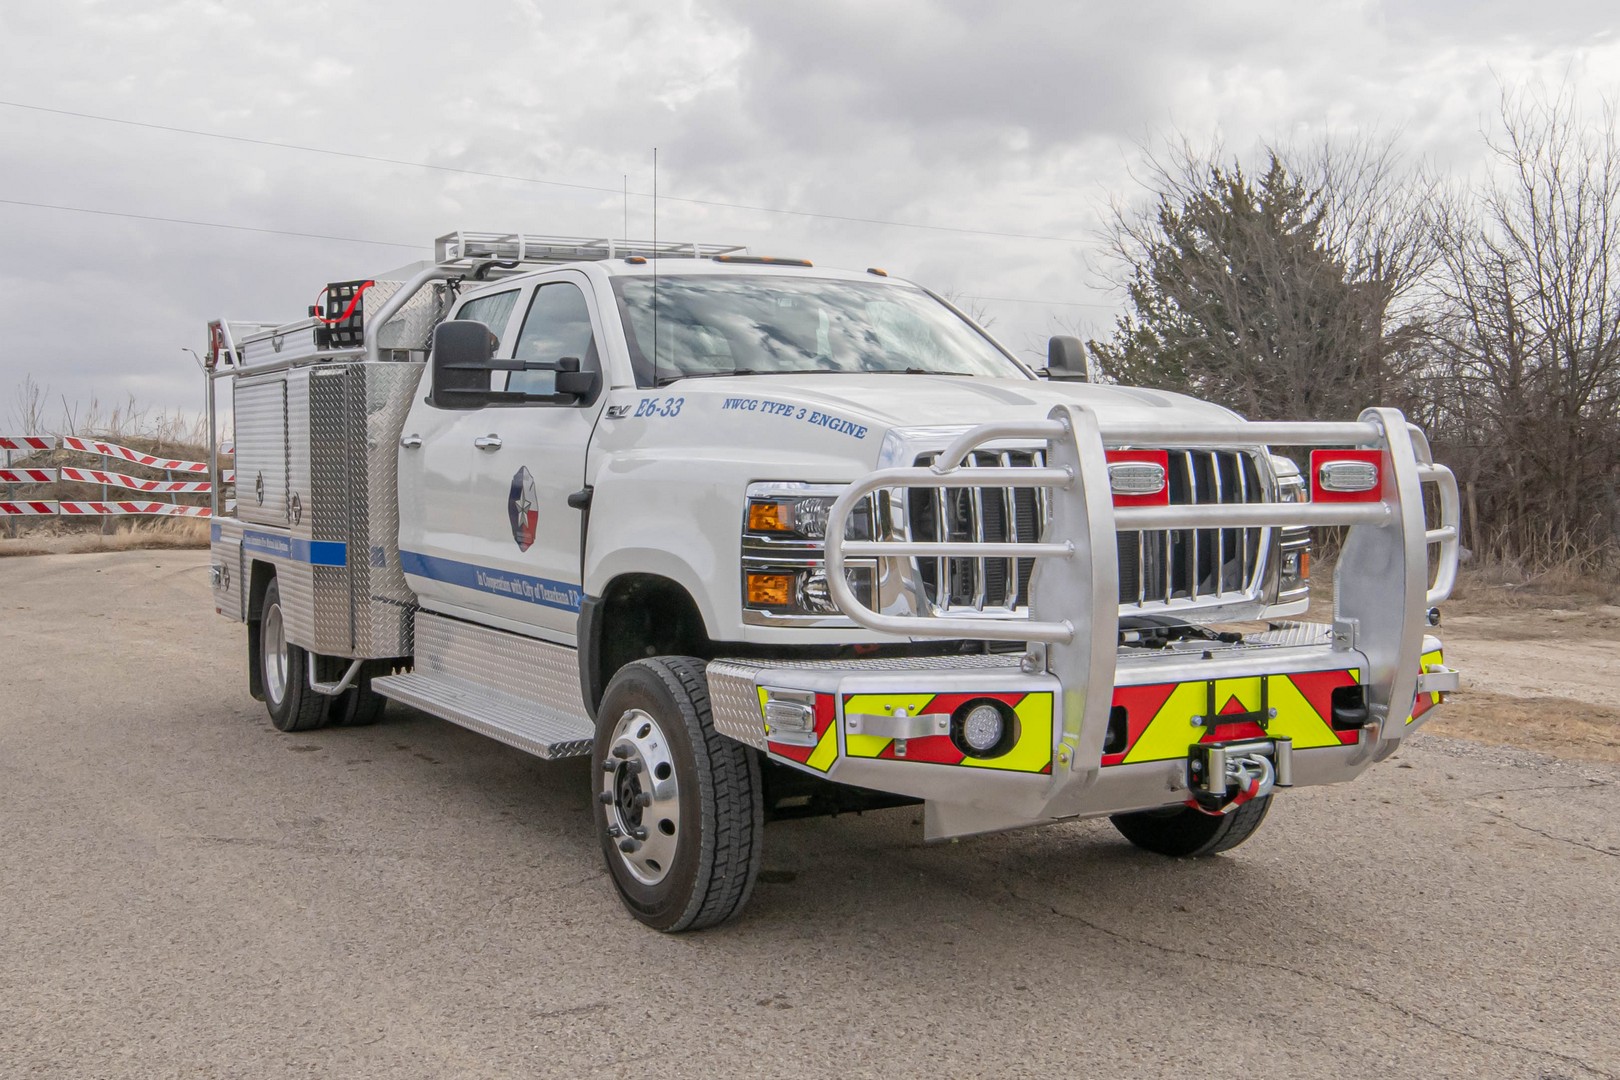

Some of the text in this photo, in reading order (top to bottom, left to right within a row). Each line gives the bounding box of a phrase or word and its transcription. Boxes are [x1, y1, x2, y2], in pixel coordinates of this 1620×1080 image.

[634, 397, 685, 417] E6-33
[722, 398, 868, 440] NWCG TYPE 3 ENGINE
[482, 572, 512, 593] Cooperation
[510, 578, 524, 596] with
[521, 580, 535, 602] City
[534, 583, 541, 600] of
